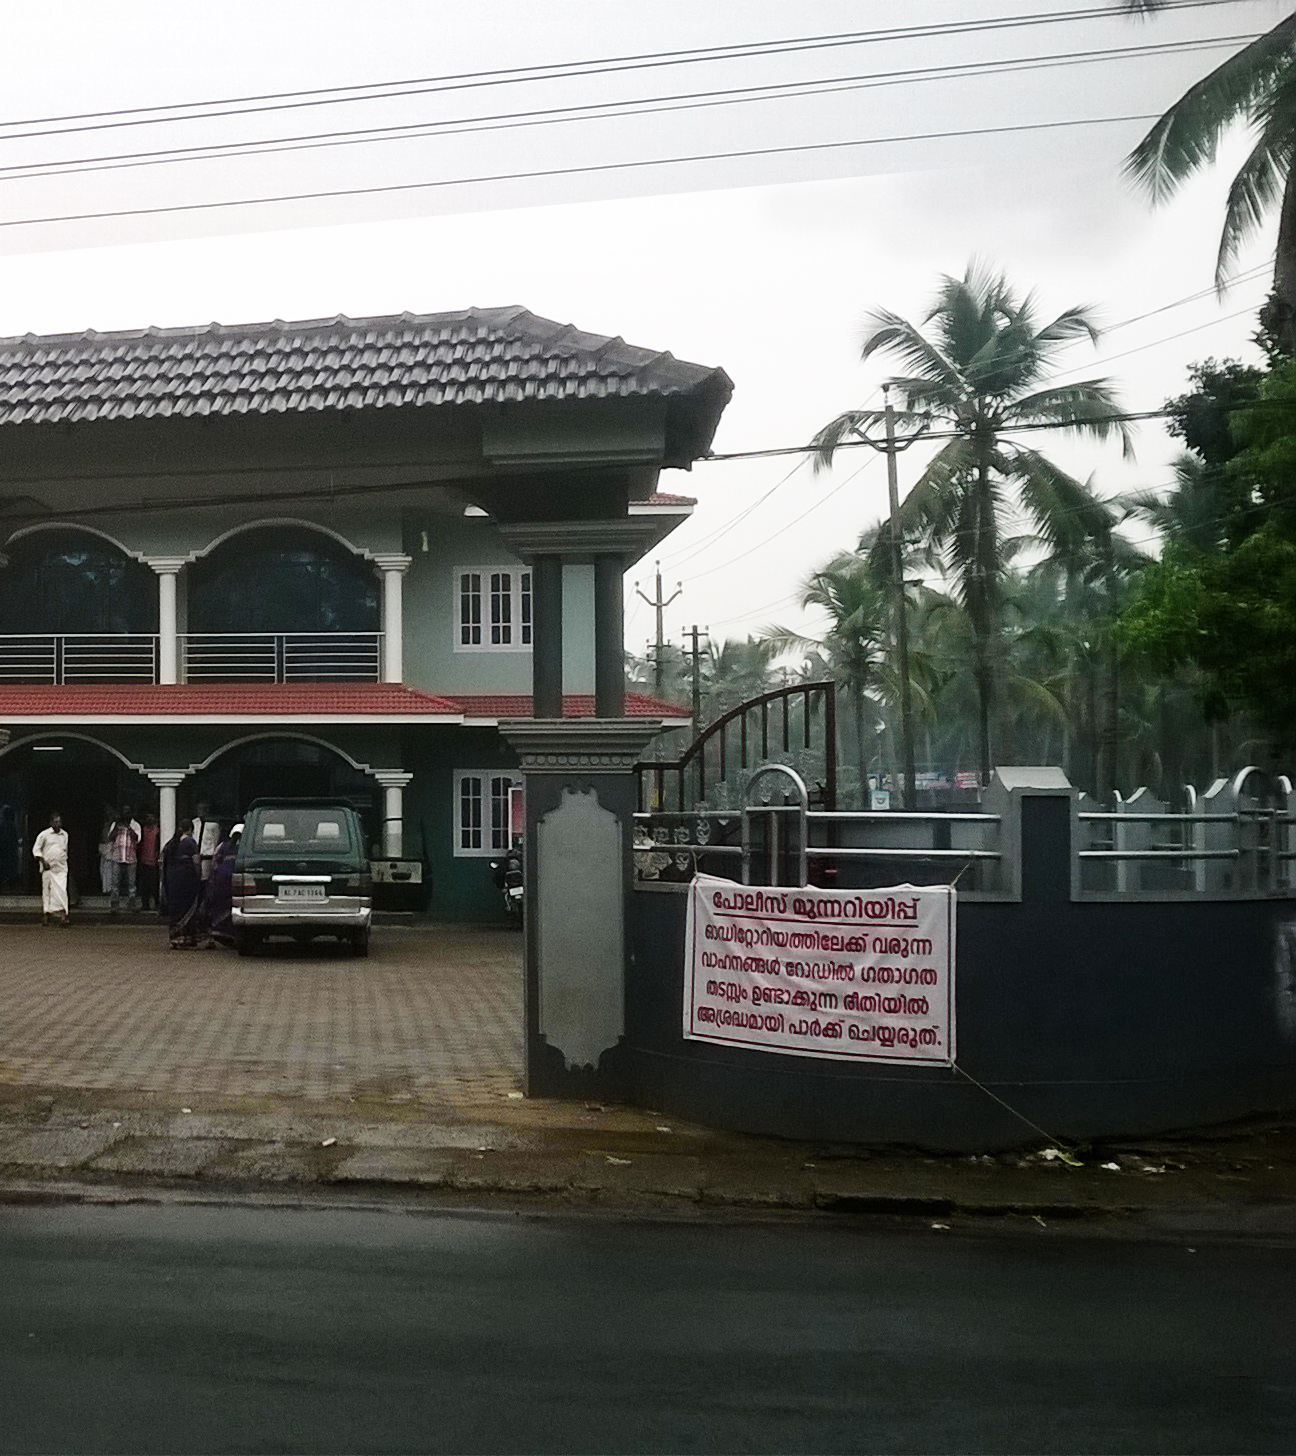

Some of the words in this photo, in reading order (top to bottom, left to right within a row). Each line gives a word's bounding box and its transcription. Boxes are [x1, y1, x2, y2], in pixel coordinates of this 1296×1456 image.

[713, 891, 788, 914] പോലീസ്
[793, 896, 920, 920] മുന്നറിയിപ്പ്
[873, 936, 932, 958] വരുന്ന
[785, 961, 855, 982] റോഡിൽ
[861, 966, 937, 985] ഗതാഗത
[706, 979, 748, 1003] തടസ്സം
[751, 986, 838, 1011] ഉണ്ടാക്കുന്ന
[844, 992, 929, 1015] രീതിയിൽ
[697, 1006, 784, 1033] അശ്രദ്ധമായി
[788, 1018, 845, 1039] പാർക്ക്
